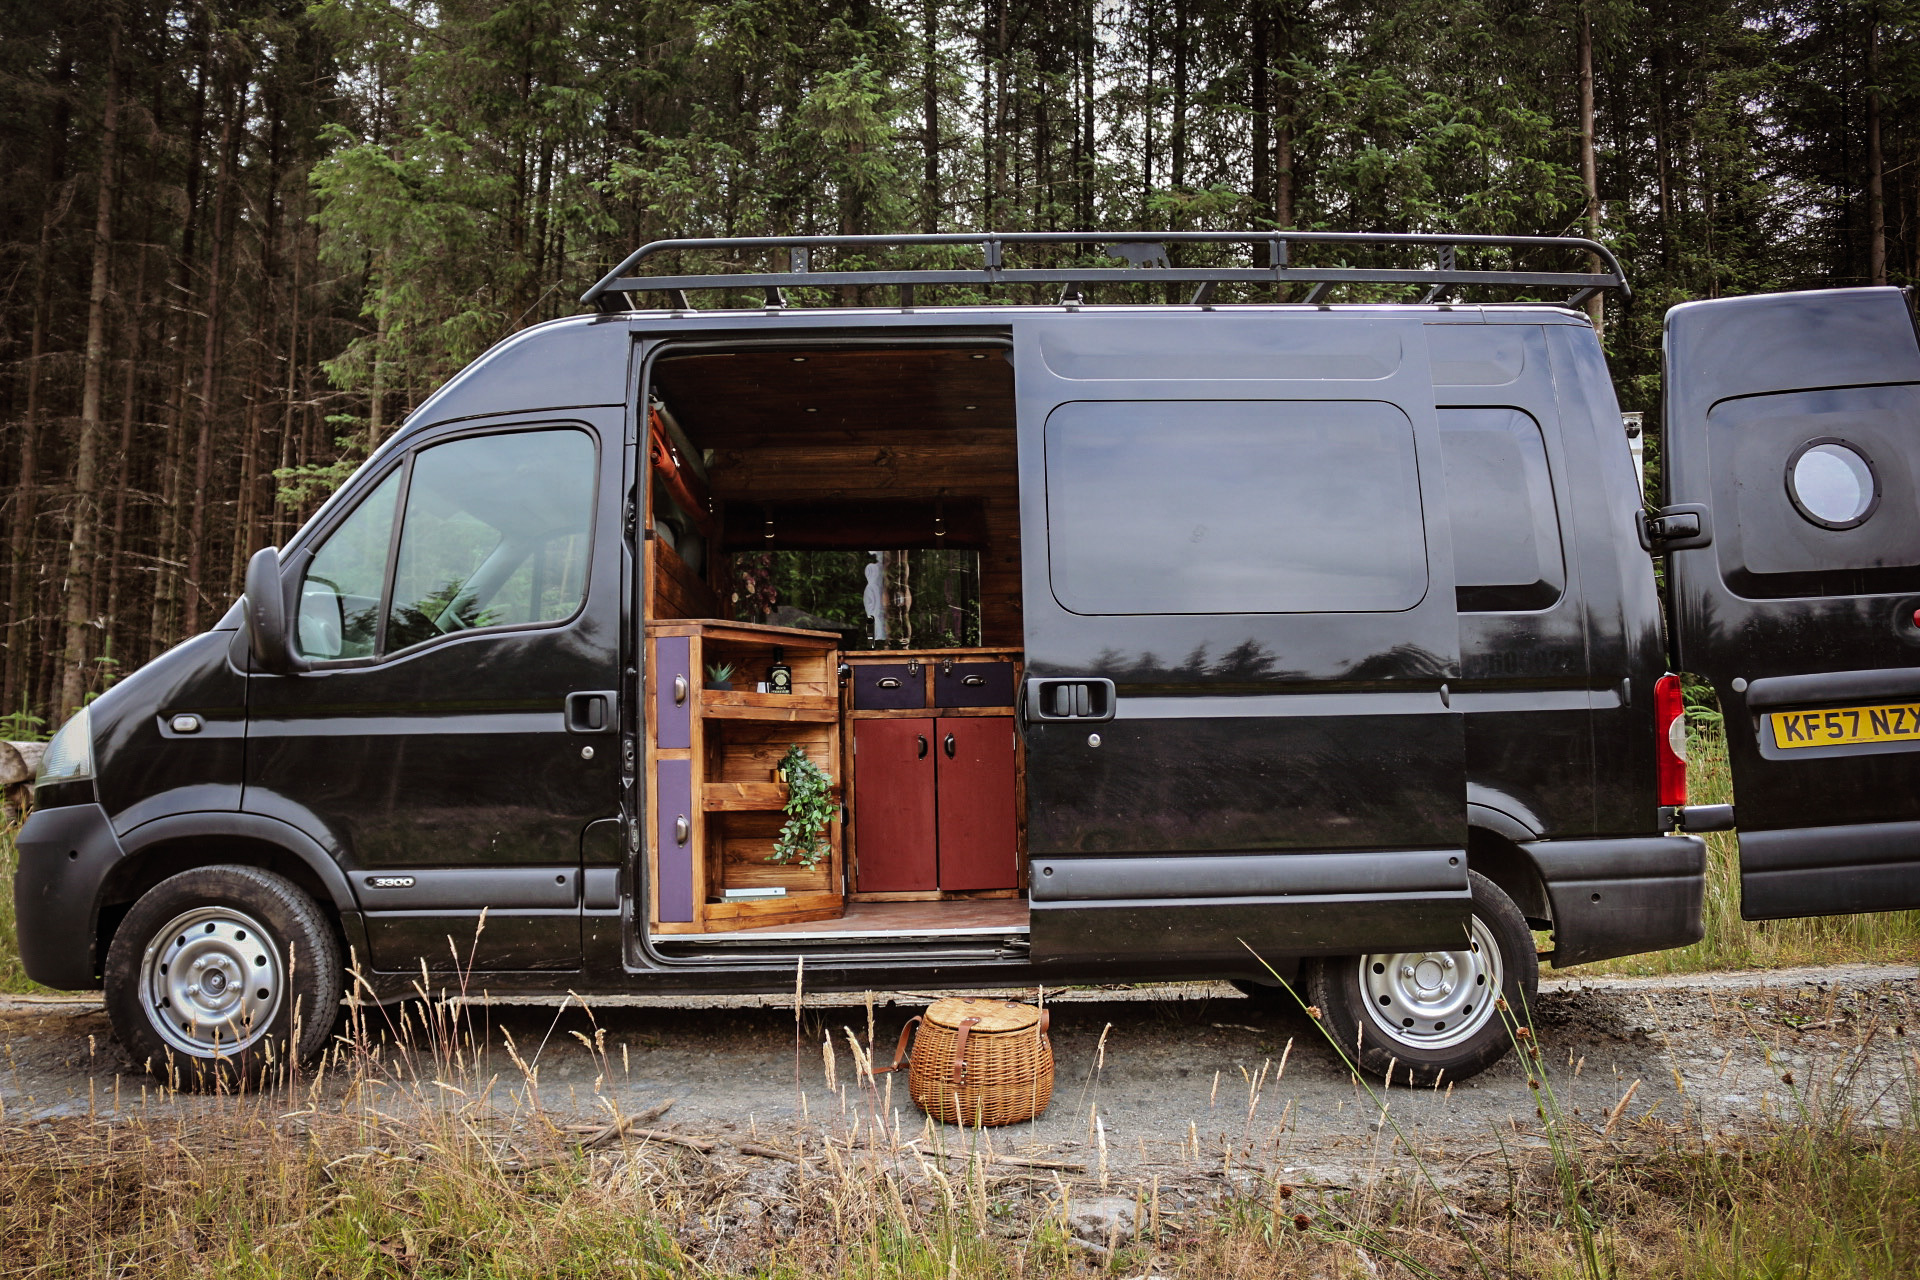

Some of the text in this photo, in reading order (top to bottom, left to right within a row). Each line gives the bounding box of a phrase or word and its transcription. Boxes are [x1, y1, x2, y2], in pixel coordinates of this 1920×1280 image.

[1783, 706, 1920, 741] KF57 NZY
[376, 878, 414, 887] 3300
